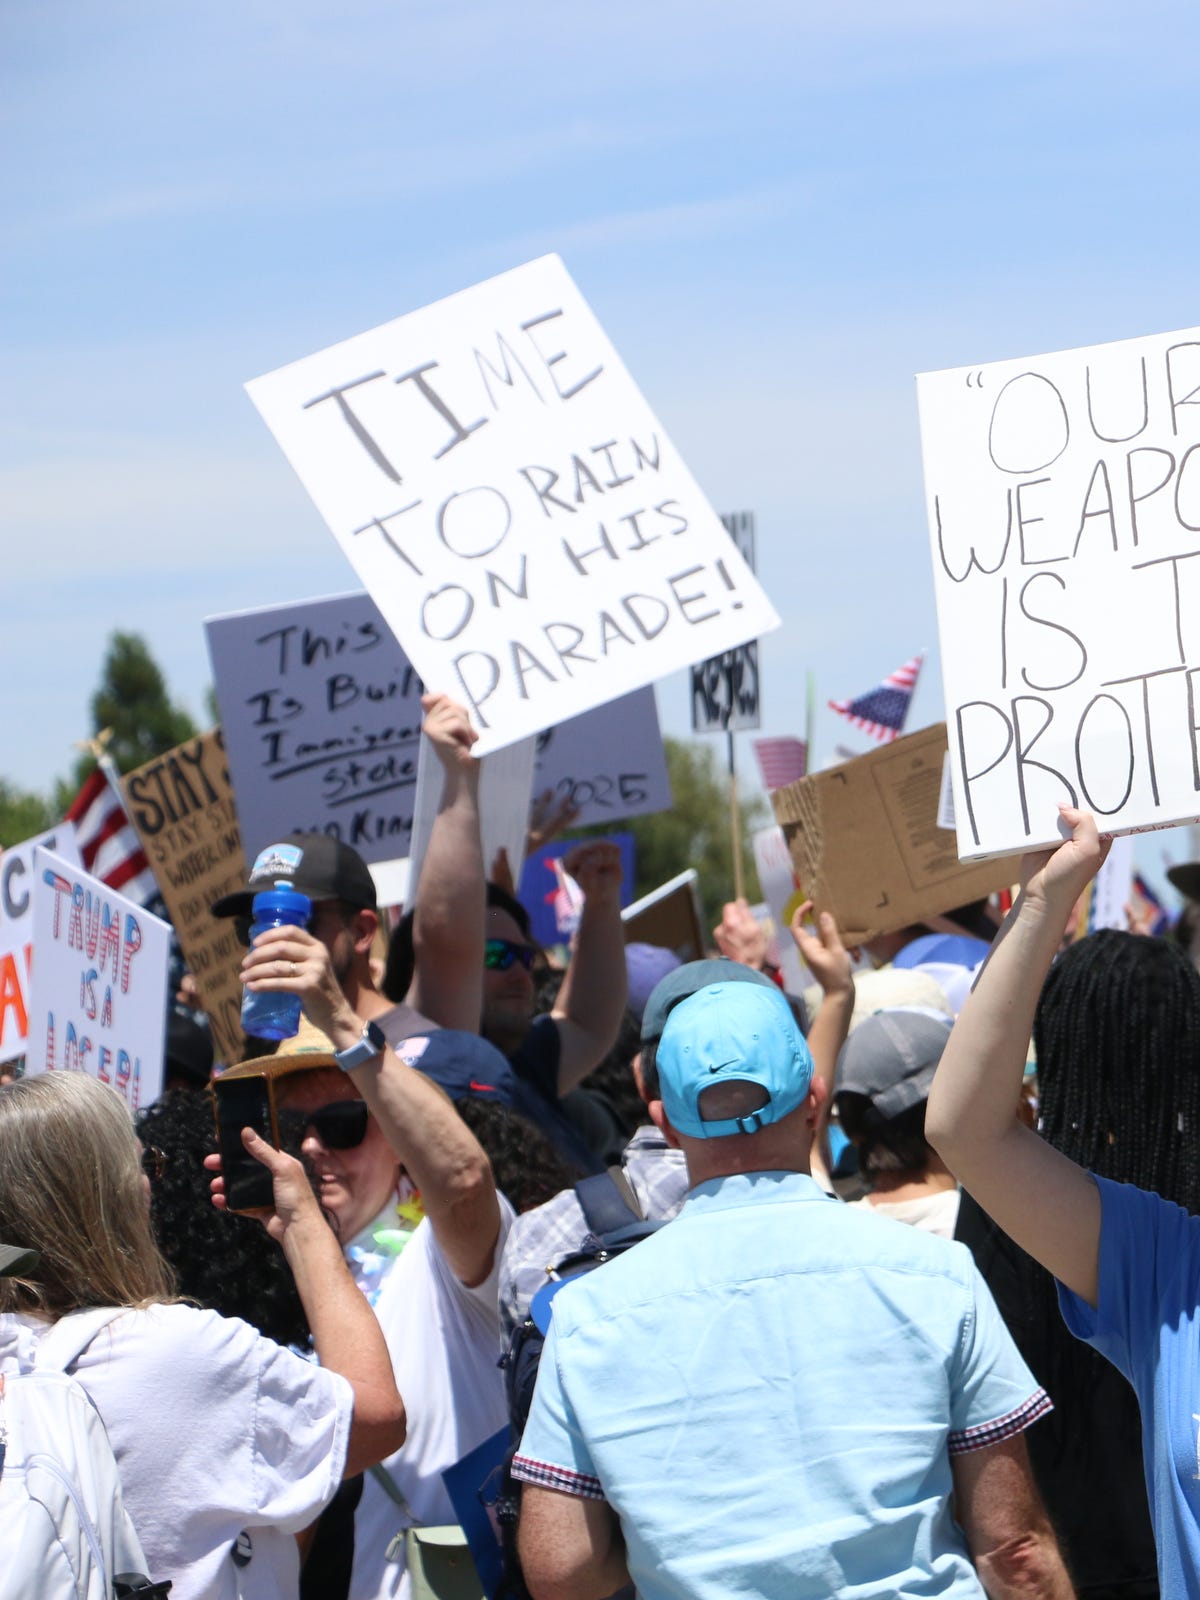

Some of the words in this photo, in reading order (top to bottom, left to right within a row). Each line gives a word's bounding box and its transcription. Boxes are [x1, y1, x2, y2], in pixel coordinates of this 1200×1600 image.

[302, 308, 604, 484] TIME
[352, 485, 512, 577] TO
[518, 431, 662, 519] RAIN
[419, 554, 530, 642] ON
[561, 500, 690, 577] HIS
[254, 622, 383, 676] This
[452, 558, 745, 729] PARADE!
[1001, 571, 1088, 692] IS
[245, 688, 304, 727] Is
[326, 666, 425, 714] Buil
[127, 740, 220, 836] STAY
[321, 754, 414, 799] Stole
[556, 772, 649, 808] 2025
[151, 815, 202, 864] STAY
[42, 868, 143, 995] TRUMP
[79, 967, 98, 1021] IS
[100, 984, 113, 1029] A
